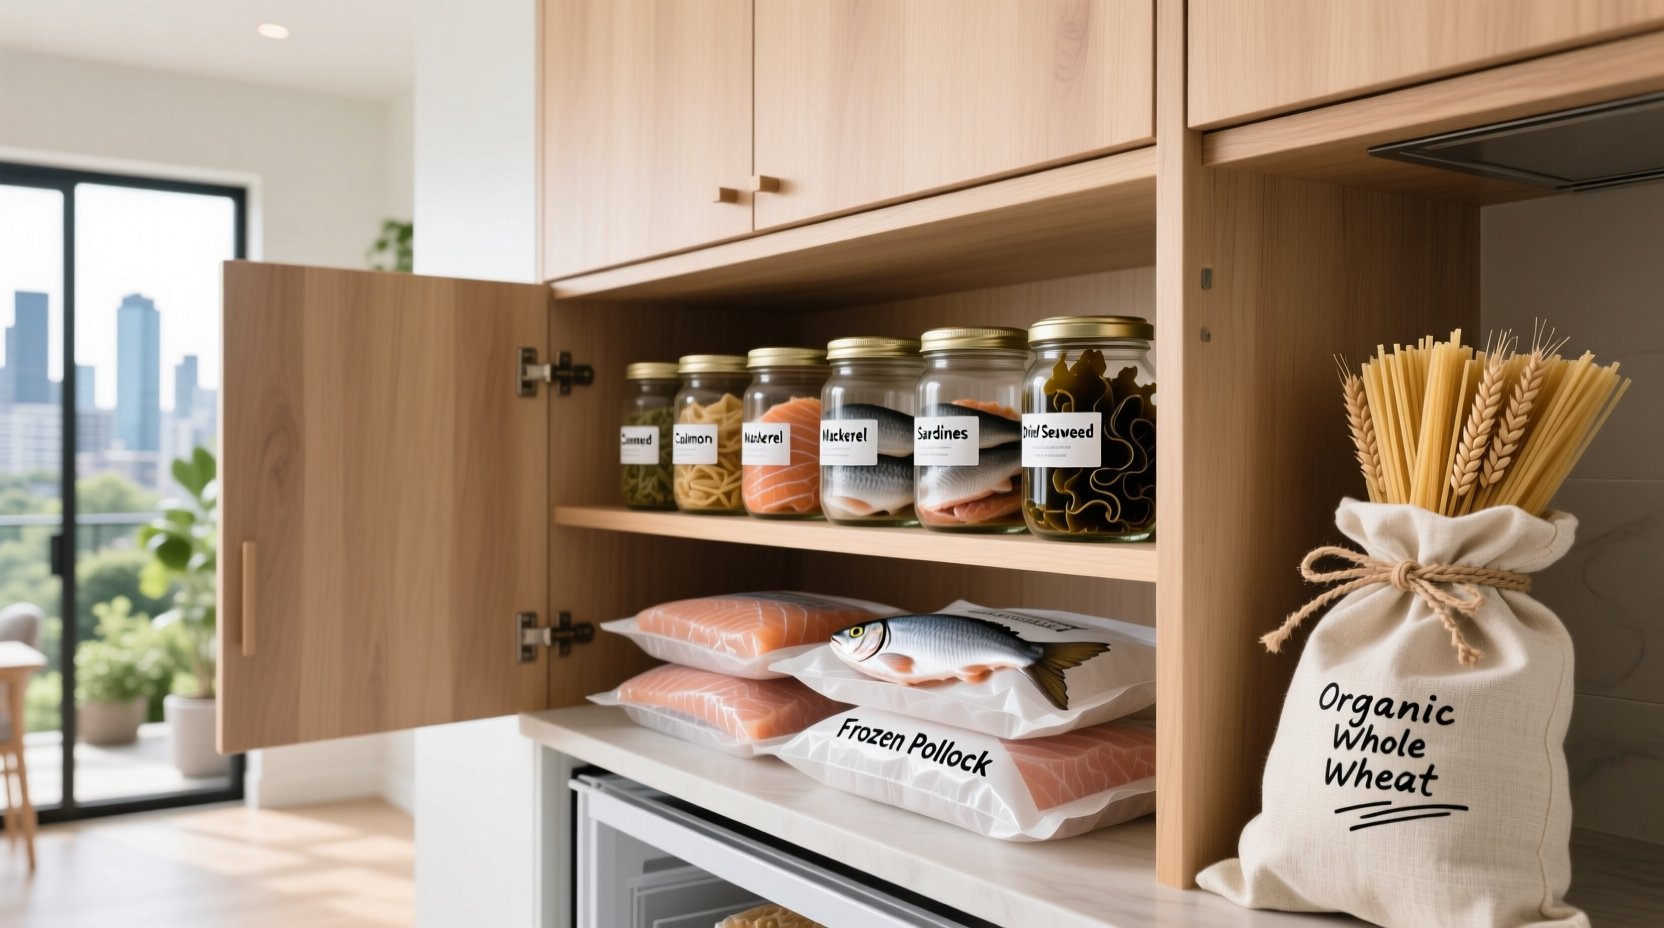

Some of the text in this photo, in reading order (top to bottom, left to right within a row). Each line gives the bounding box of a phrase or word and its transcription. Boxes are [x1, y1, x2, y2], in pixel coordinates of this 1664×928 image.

[917, 425, 969, 440] Sardines
[1319, 682, 1455, 728] Organic
[836, 718, 994, 777] Frozen Pollock
[1333, 723, 1426, 758] Whole
[1325, 757, 1439, 797] Wheat
